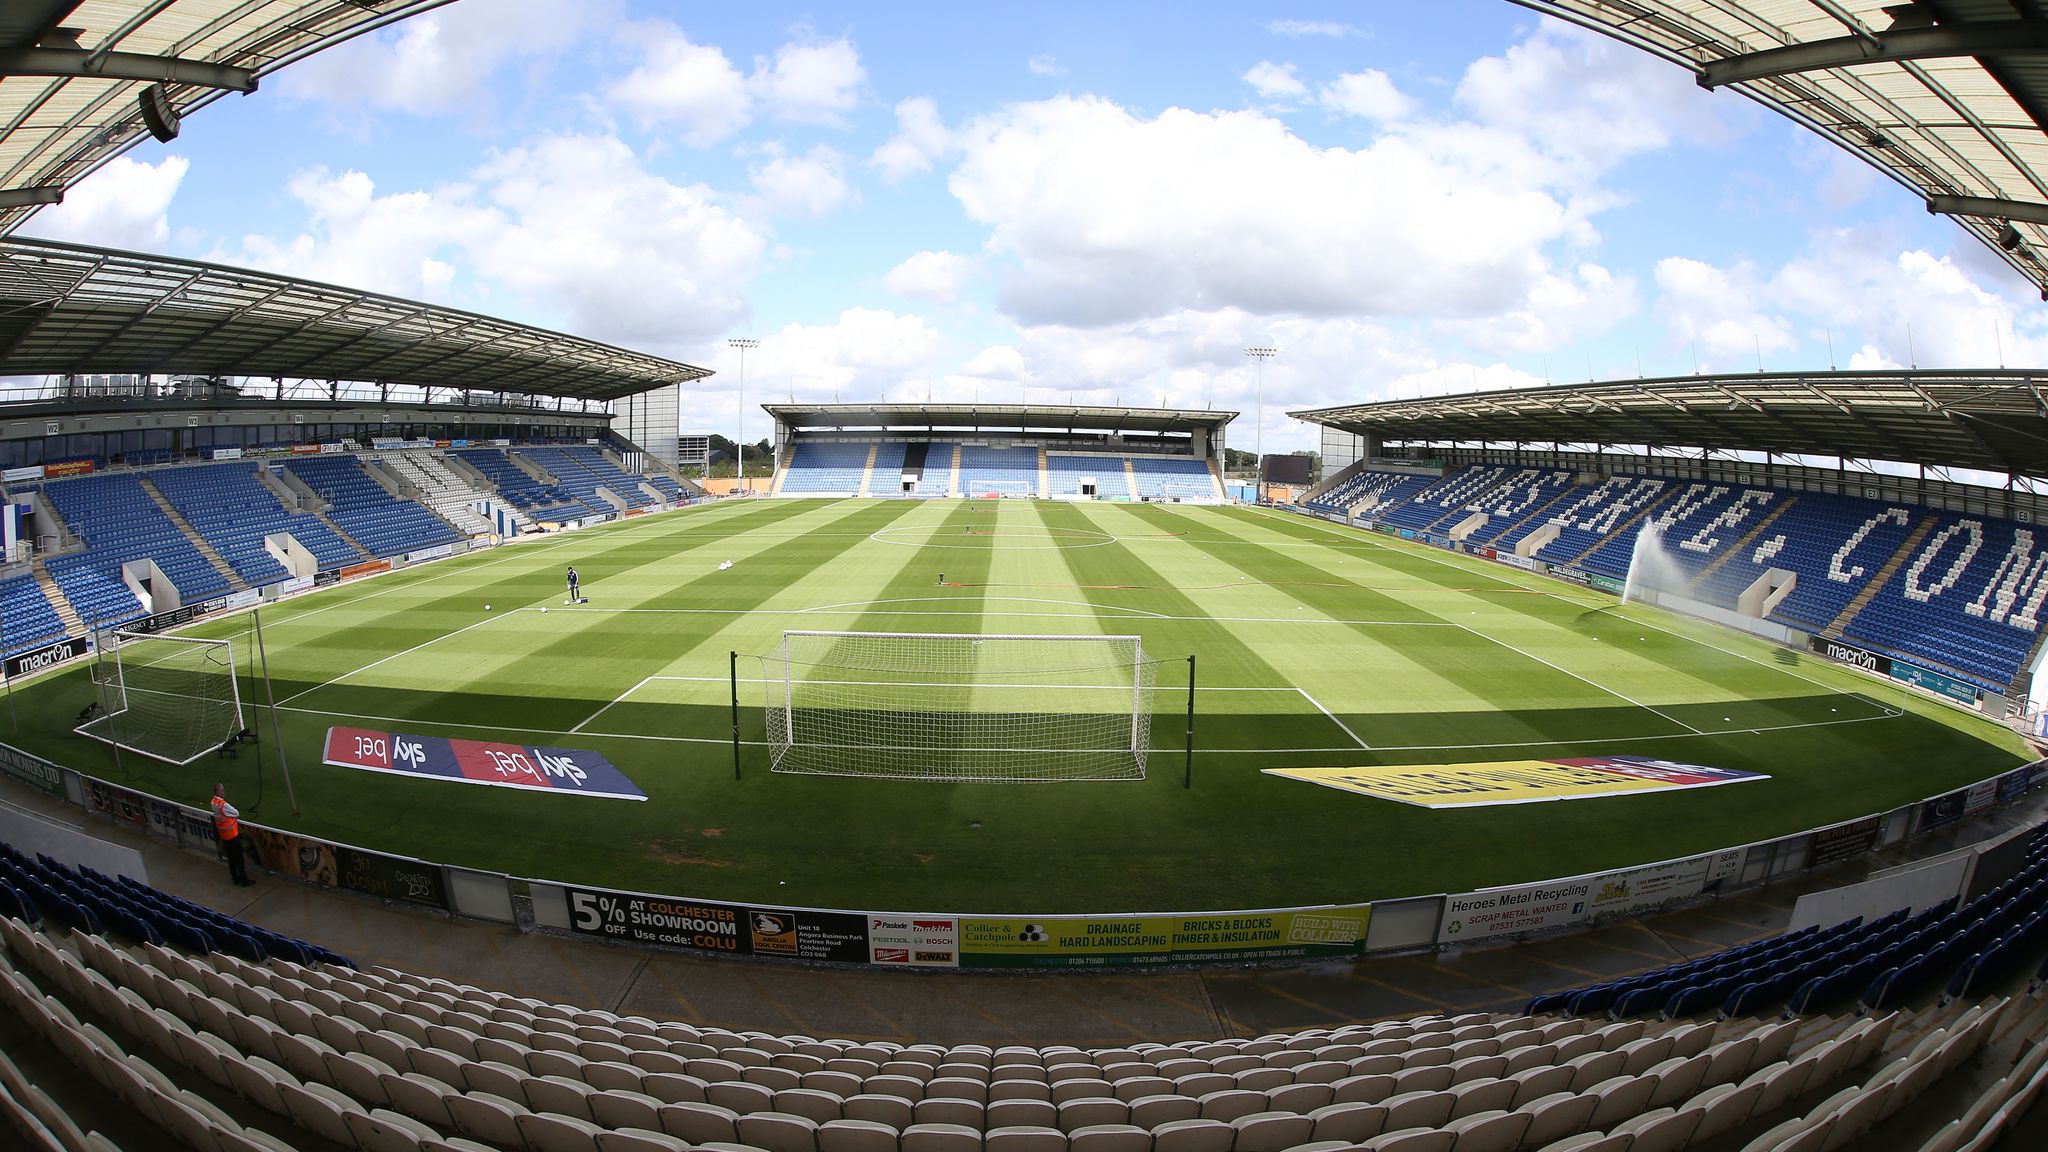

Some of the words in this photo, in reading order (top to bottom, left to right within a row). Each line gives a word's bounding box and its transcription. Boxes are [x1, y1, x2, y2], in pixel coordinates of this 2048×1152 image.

[1868, 490, 1876, 498] E7
[2020, 512, 2028, 522] E8
[20, 645, 72, 672] macron
[1827, 644, 1876, 670] macron
[354, 736, 388, 765] bet
[393, 736, 426, 768] sky
[485, 750, 542, 782] bet
[534, 749, 588, 787] sky
[44, 766, 60, 784] LTD
[1720, 851, 1740, 862] SEATS
[408, 882, 429, 896] ZOO
[1451, 899, 1496, 912] Heroes
[1500, 892, 1532, 906] Metal
[1534, 885, 1589, 902] Recycling
[572, 892, 625, 930] 5%
[630, 900, 645, 910] AT
[649, 902, 735, 921] COLCHESTER
[1468, 914, 1500, 924] SCRAP
[1502, 908, 1530, 920] METAL
[1532, 903, 1568, 914] WANTED
[605, 924, 626, 934] OFF
[630, 912, 737, 935] SHOWROOM
[966, 924, 1000, 932] Collier
[1002, 924, 1012, 932] &
[1088, 924, 1142, 934] DRAINAGE
[1184, 920, 1224, 932] BRICKS
[1224, 920, 1232, 930] &
[1233, 918, 1272, 930] BLOCKS
[1294, 917, 1329, 929] BUILD
[1332, 919, 1360, 931] WITH
[1490, 922, 1514, 931] 07531
[634, 929, 656, 940] Use
[659, 932, 691, 945] code:
[694, 936, 736, 950] COLU
[873, 936, 910, 944] FESTOOL
[966, 932, 1016, 942] Catchpole
[1060, 936, 1090, 947] HARD
[1092, 934, 1166, 947] LANDSCAPING
[1172, 932, 1210, 944] TIMBER
[1211, 932, 1220, 942] &
[1221, 930, 1280, 942] INSULATION
[1292, 928, 1358, 942] COLLIERS
[800, 944, 830, 952] Colchester
[1258, 950, 1264, 958] TO
